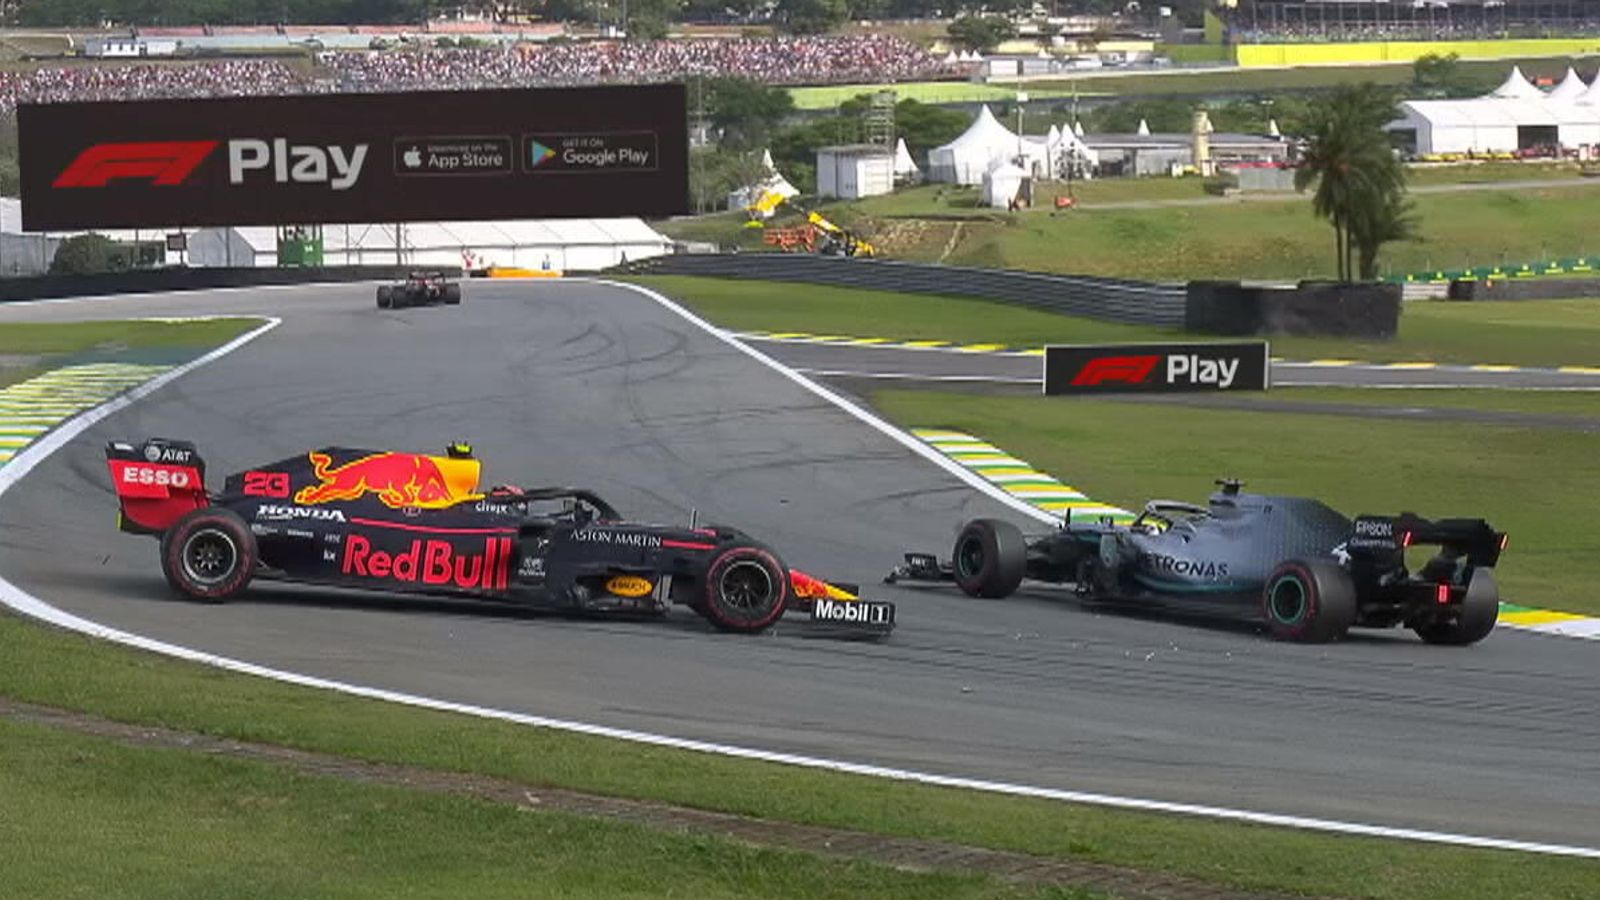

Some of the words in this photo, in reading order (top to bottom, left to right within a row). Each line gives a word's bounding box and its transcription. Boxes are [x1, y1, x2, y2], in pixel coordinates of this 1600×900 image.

[228, 138, 369, 190] Play
[428, 153, 460, 168] App
[462, 152, 503, 167] Store
[563, 148, 616, 165] Google
[619, 147, 649, 166] Play
[1167, 354, 1240, 388] Play
[161, 449, 191, 462] AT&T
[244, 471, 290, 497] 23
[257, 505, 346, 522] HONDA
[570, 529, 612, 544] ASTON
[615, 533, 661, 548] MARTIN
[815, 599, 869, 622] Mobil
